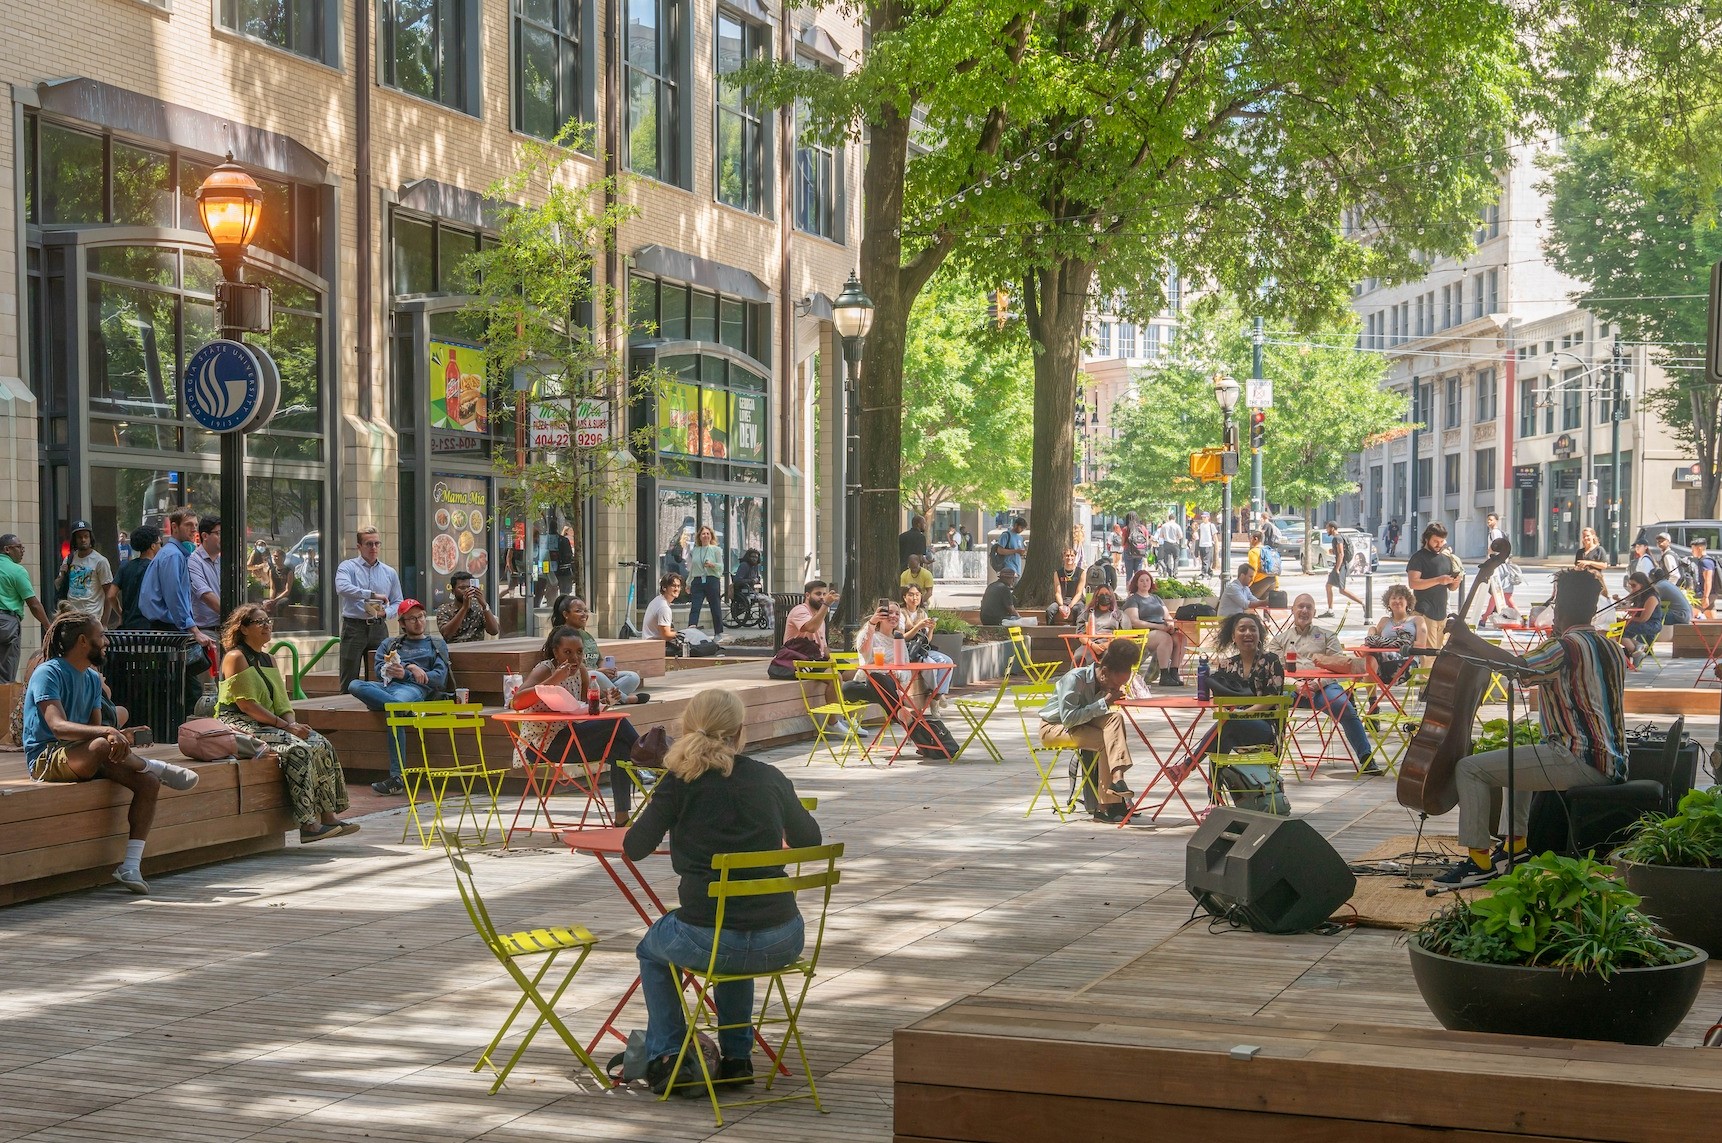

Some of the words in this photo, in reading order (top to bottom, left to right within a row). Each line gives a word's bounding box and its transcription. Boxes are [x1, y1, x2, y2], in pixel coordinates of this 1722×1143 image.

[187, 365, 201, 416] GEORGIA
[198, 345, 227, 362] STATE
[232, 350, 255, 413] UNIVERSITY
[210, 419, 233, 428] 1913
[739, 422, 758, 449] DEW
[442, 488, 468, 506] Mama
[469, 490, 485, 507] Mia
